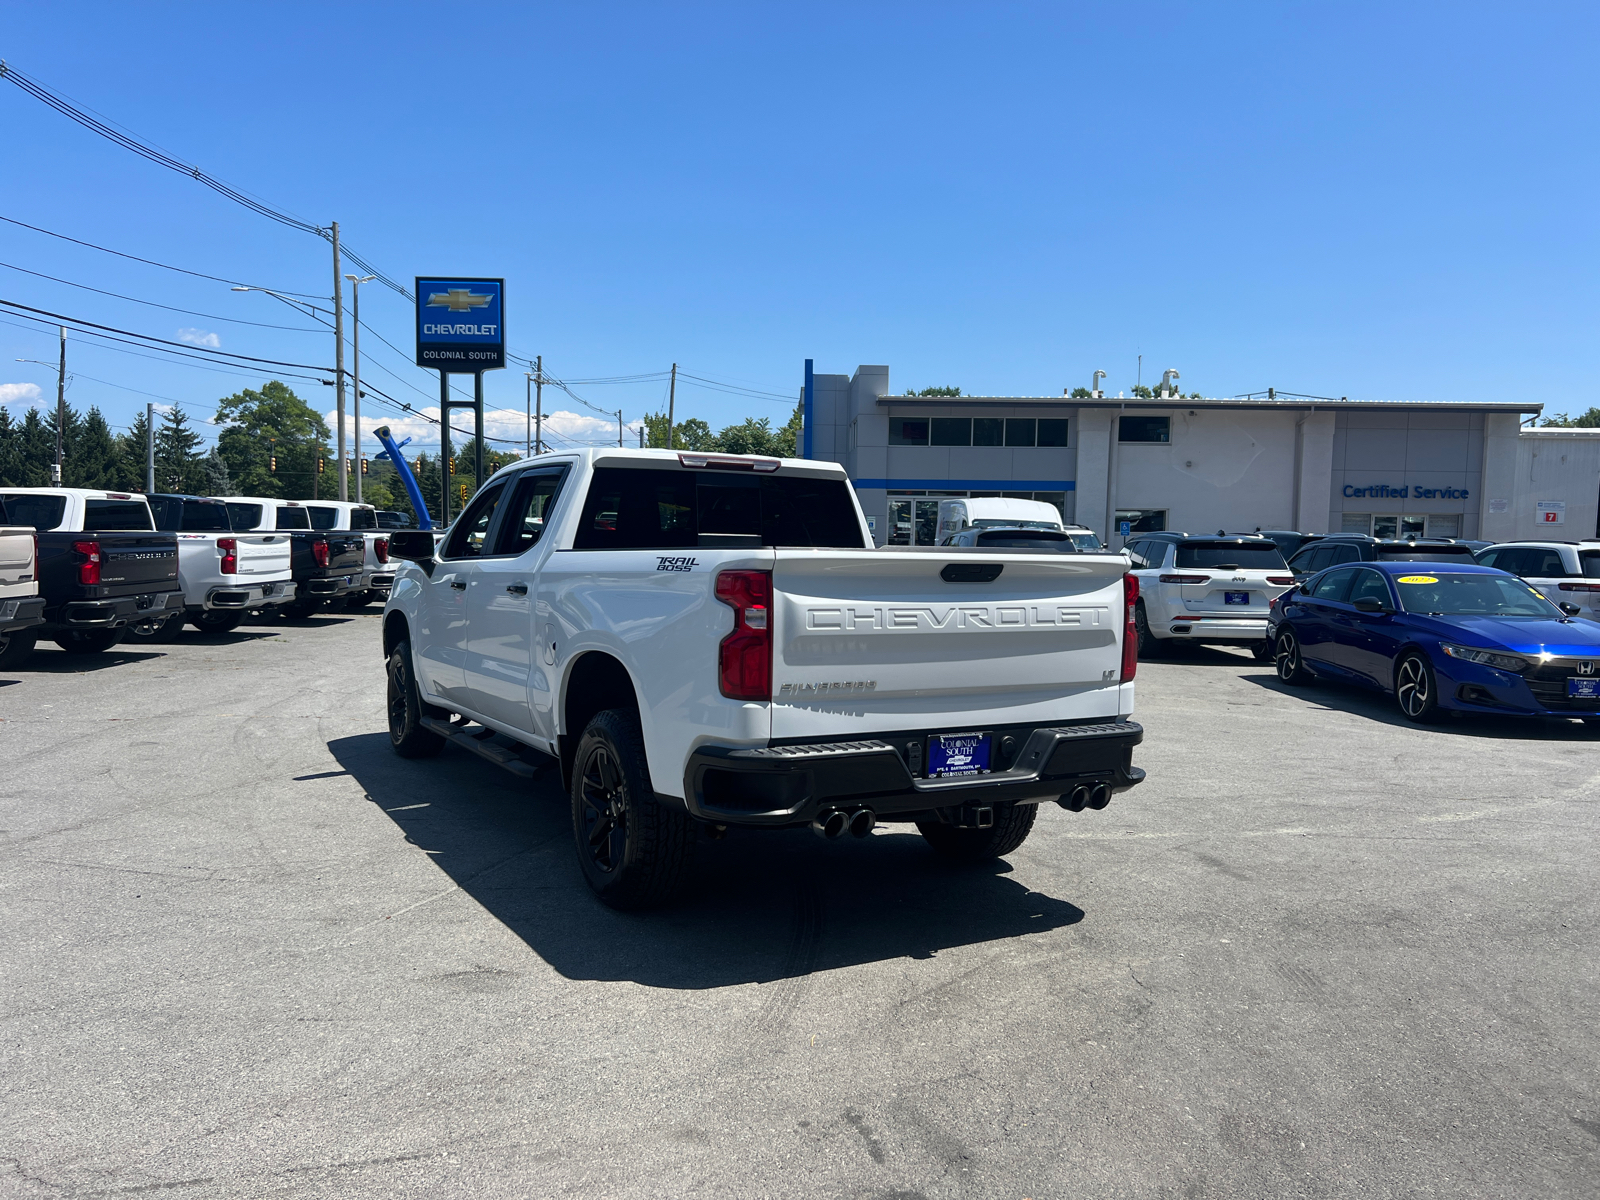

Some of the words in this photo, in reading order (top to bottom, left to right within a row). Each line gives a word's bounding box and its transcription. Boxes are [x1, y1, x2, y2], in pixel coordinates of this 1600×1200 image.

[424, 324, 497, 335] CHEVROLET
[423, 351, 466, 359] COLONIAL
[1343, 485, 1409, 498] Certified
[1413, 486, 1469, 499] Service
[1548, 513, 1554, 521] 7
[656, 557, 699, 565] TRAIL
[656, 564, 692, 572] BOSS
[806, 607, 1109, 630] CHEVROLET
[780, 681, 877, 691] SILVERADO
[941, 739, 979, 749] COLONIAL
[946, 747, 973, 756] SOUTH
